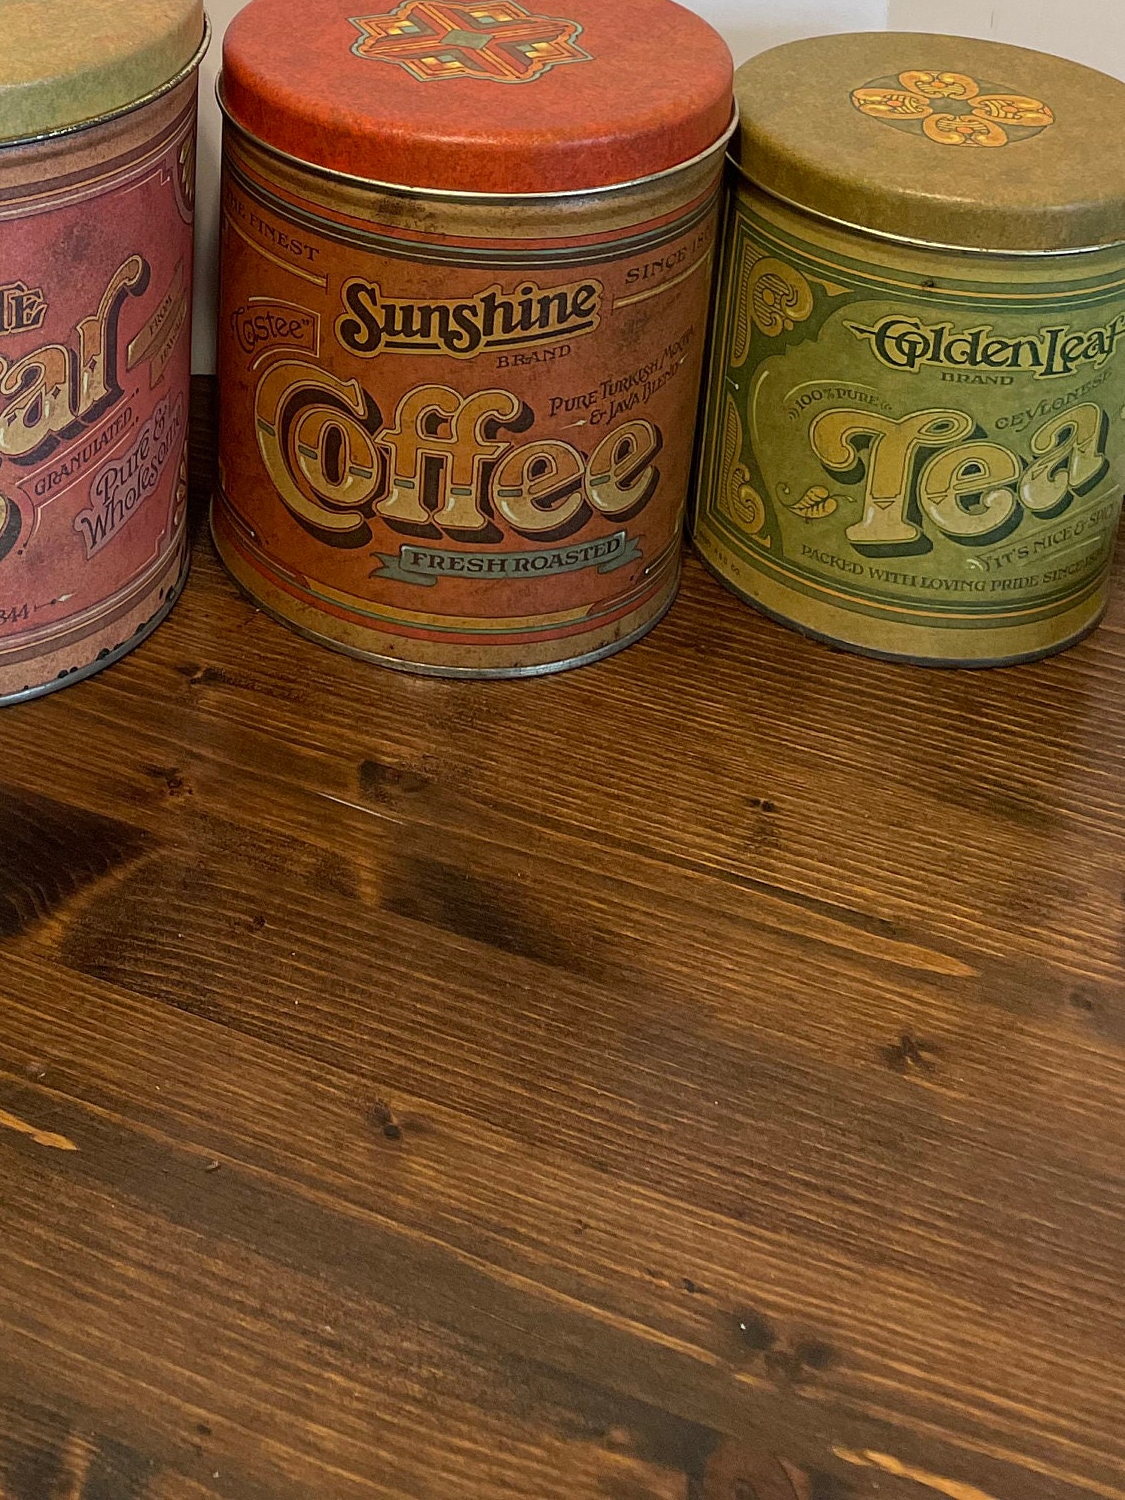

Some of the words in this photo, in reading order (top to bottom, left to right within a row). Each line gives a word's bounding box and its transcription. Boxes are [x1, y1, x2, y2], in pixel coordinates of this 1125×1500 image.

[249, 212, 320, 261] FINEST
[625, 246, 686, 284] SINCE
[338, 279, 599, 355] Sunshine
[495, 344, 572, 369] BRAND
[941, 371, 1014, 386] BRAND
[548, 390, 598, 417] PURE
[589, 406, 606, 426] &
[606, 394, 640, 426] JAVA
[641, 360, 680, 404] BLEND
[34, 406, 133, 496] GRANULATED
[96, 429, 150, 503] Pure
[254, 358, 663, 548] Coffee
[809, 402, 1109, 558] Tea
[410, 551, 506, 573] FRESH
[513, 537, 621, 571] ROASTED
[1033, 525, 1074, 554] NICE
[801, 544, 865, 575] PACKED
[868, 567, 917, 586] WITH
[921, 575, 987, 592] LOVING
[990, 575, 1039, 591] PRIDE
[1042, 560, 1084, 584] SINCE
